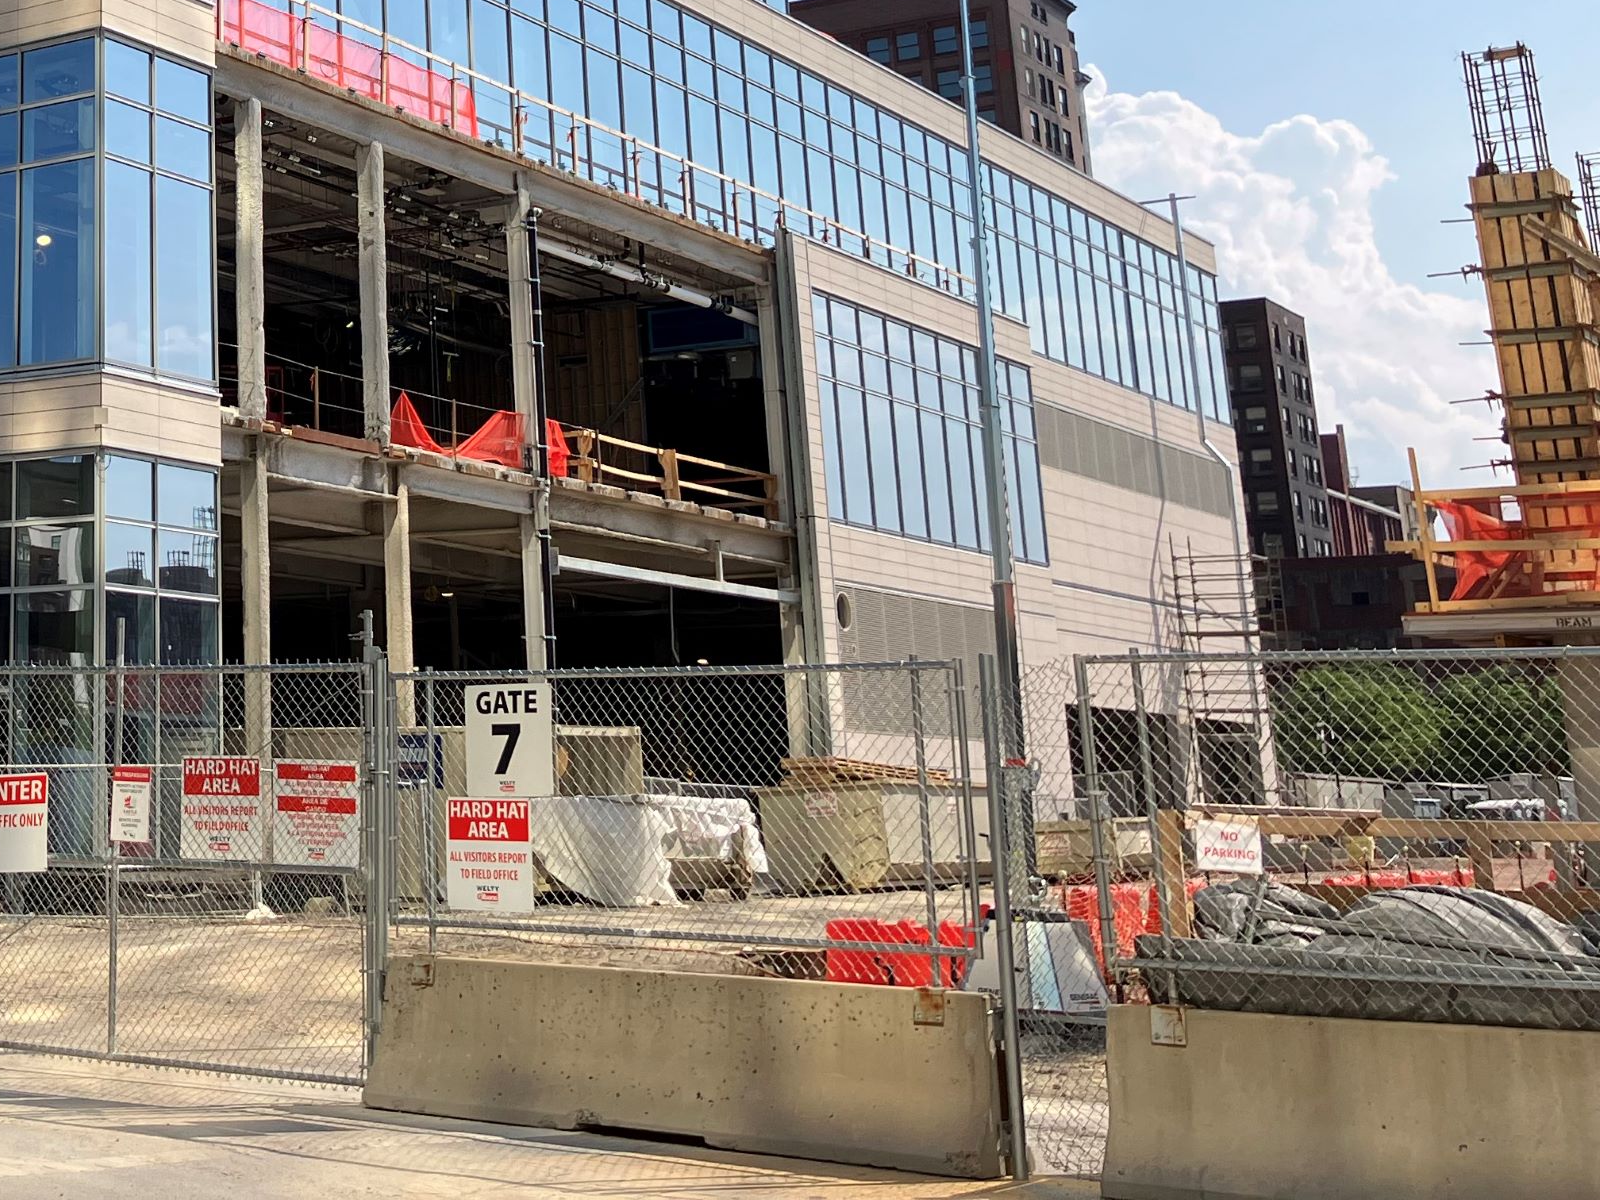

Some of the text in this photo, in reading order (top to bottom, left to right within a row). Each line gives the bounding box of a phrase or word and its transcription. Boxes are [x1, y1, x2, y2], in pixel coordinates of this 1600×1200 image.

[1555, 616, 1592, 628] BEAM
[476, 690, 538, 714] GATE
[491, 723, 521, 775] 7
[185, 759, 258, 775] HARD HAT
[201, 778, 241, 793] AREA
[184, 805, 258, 816] ALL VISITORS REPORT
[450, 801, 528, 819] HARD HAT
[20, 812, 44, 827] ONLY
[194, 821, 249, 831] TO FIELD OFFICE
[467, 821, 509, 839] AREA
[1220, 831, 1238, 842] NO
[450, 851, 528, 864] ALL VISITORS REPORT
[1204, 847, 1256, 860] PARKING
[460, 868, 518, 881] TO FIELD OFFICE
